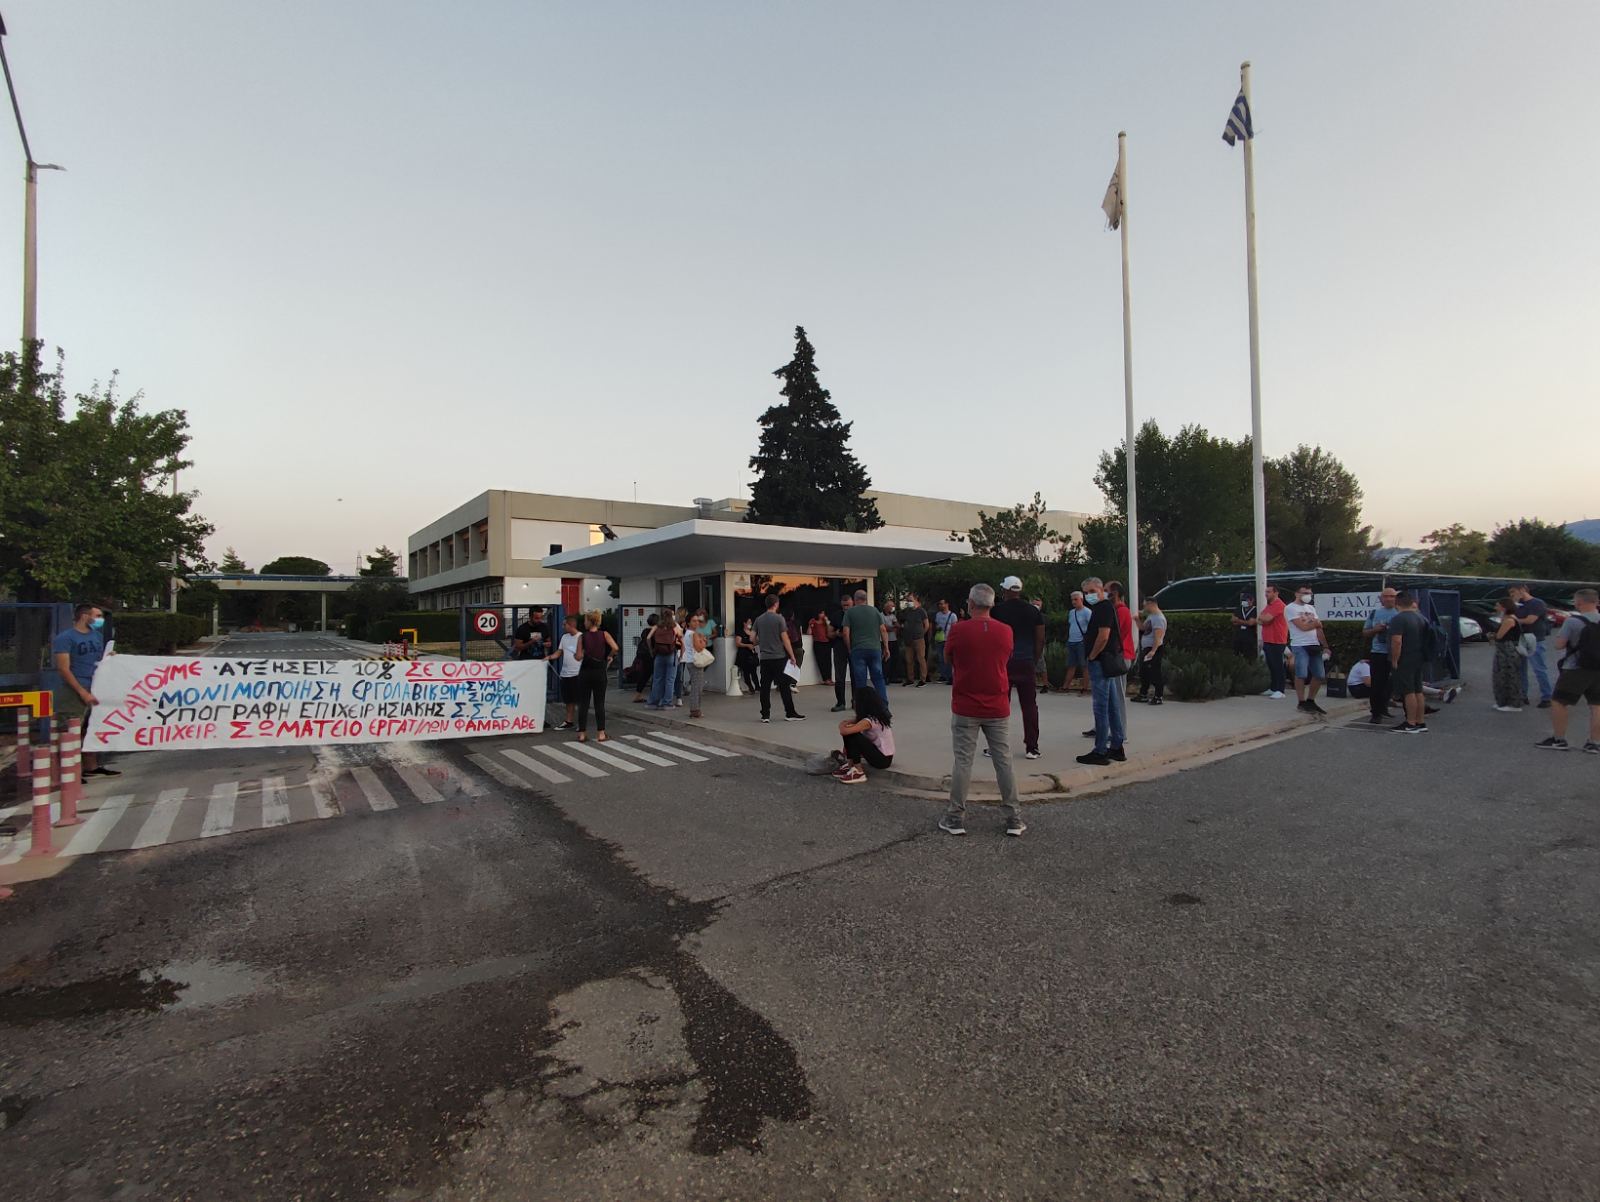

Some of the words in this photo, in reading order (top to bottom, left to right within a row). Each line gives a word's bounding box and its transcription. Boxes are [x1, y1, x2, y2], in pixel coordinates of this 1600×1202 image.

[480, 617, 495, 627] 20
[219, 661, 338, 676] ΑΥΞΗΣΕΙΣ
[352, 662, 395, 679] 10%
[406, 662, 434, 677] ΣΕ
[442, 662, 505, 678] ΟΛΟΥΣ
[96, 661, 202, 744] ΑΠΑΙΤΟΥΜΕ
[158, 680, 341, 708] ΜΟΝΙΜΟΠΟΙΗΣΗ
[155, 702, 290, 725] ΥΠΟΓΡΑΦΗ
[230, 720, 362, 739] ΣΩΜΑΤΕΙΟ
